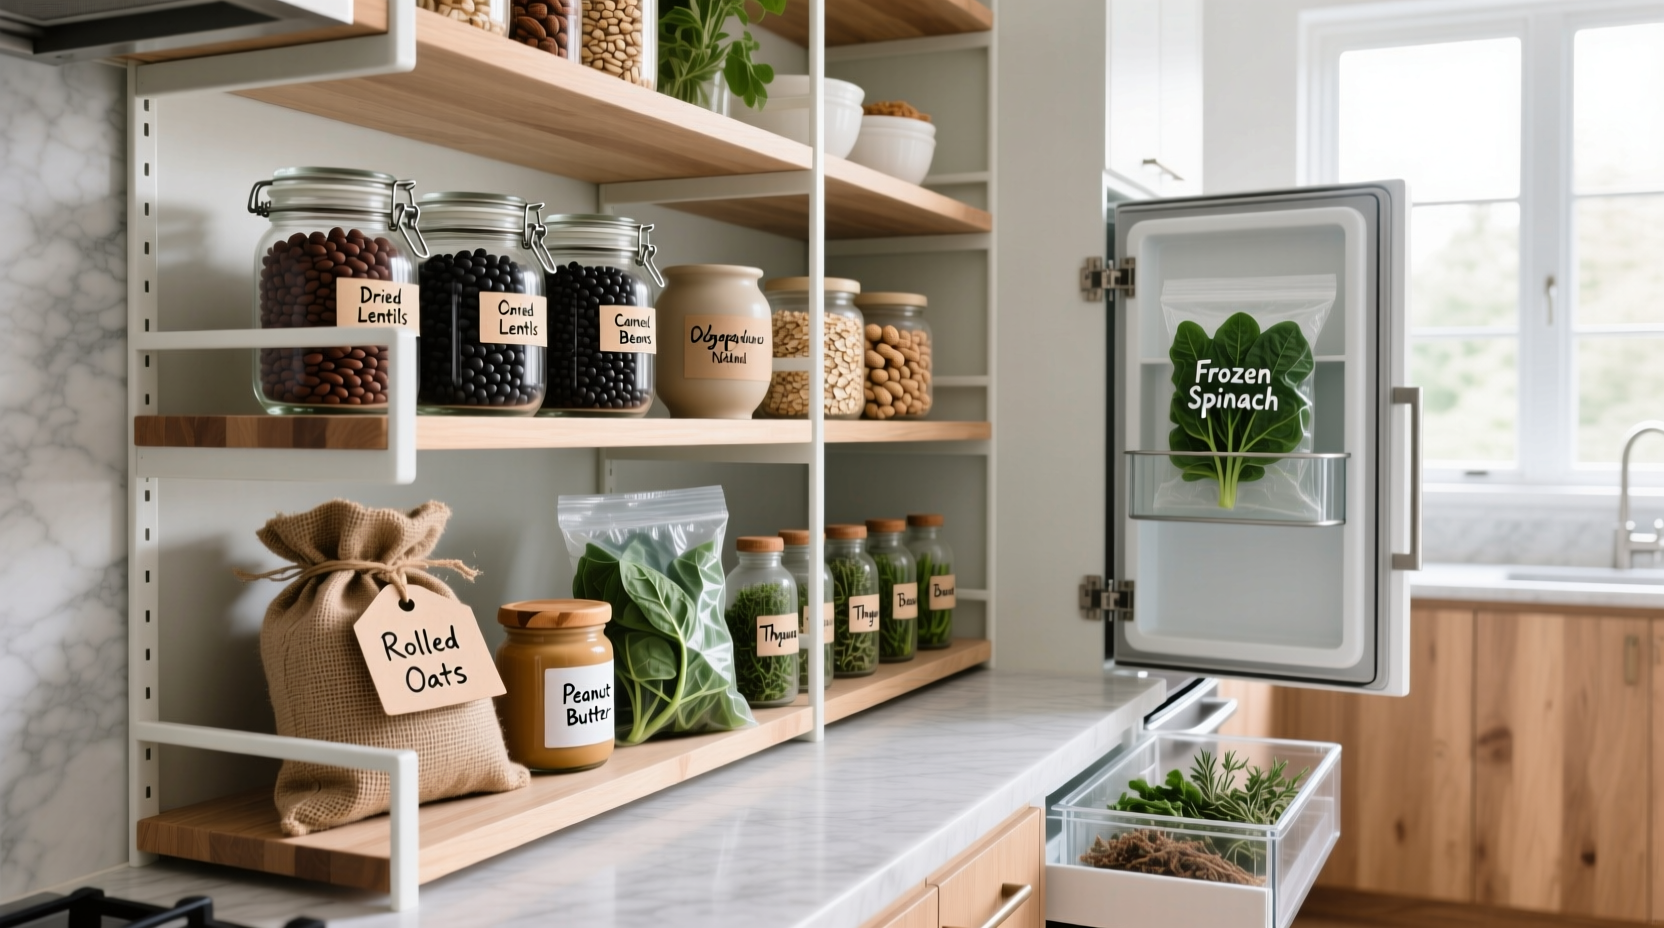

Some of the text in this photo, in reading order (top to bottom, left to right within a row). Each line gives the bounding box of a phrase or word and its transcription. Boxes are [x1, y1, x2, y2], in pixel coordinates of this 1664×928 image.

[360, 286, 401, 304] Dried
[358, 306, 407, 325] Lentils
[500, 318, 538, 336] Lentls
[1195, 359, 1271, 384] Frozen
[1187, 385, 1279, 419] Spinach
[381, 624, 459, 661] Rolled
[405, 663, 467, 693] Oats
[563, 683, 611, 705] Peanut
